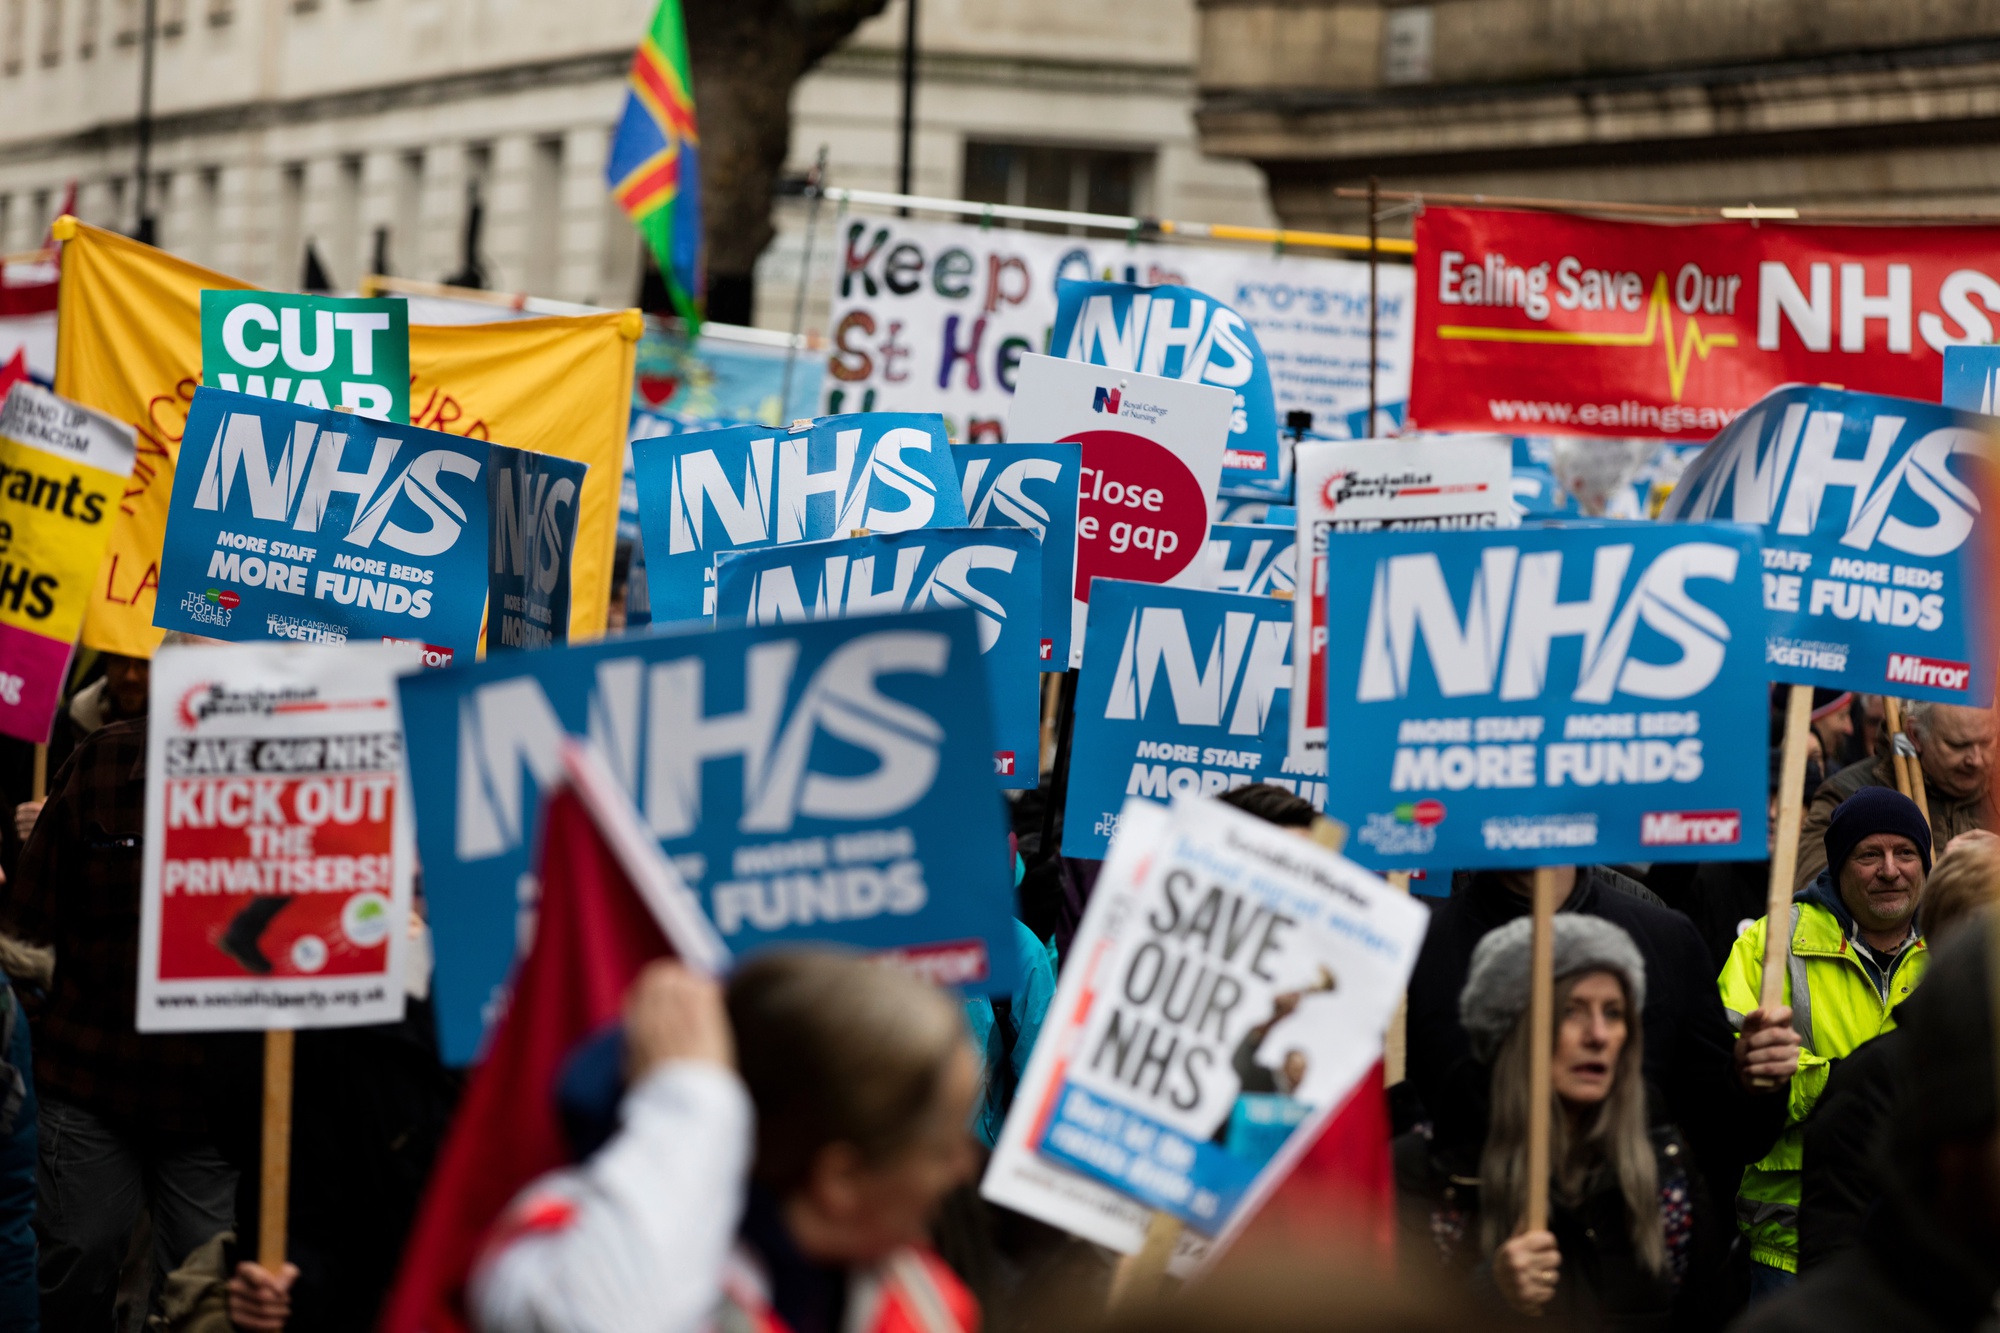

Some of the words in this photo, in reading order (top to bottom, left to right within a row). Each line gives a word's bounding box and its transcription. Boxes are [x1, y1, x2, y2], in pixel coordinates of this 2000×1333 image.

[840, 222, 1031, 314] Keep
[1438, 250, 1551, 321] Ealing
[1556, 255, 1643, 313] Save
[1675, 262, 1741, 316] Our
[221, 301, 390, 372] CUT
[1757, 260, 2000, 357] NHS
[828, 310, 910, 383] St
[1065, 293, 1255, 387] NHS
[1123, 400, 1142, 412] Royal
[1142, 403, 1169, 417] College
[1130, 410, 1157, 425] Nursing
[1488, 397, 1749, 434] www.ealingsav
[193, 410, 482, 557] NHS
[669, 427, 938, 556] NHS
[1685, 403, 1998, 557] NHS
[216, 530, 269, 553] MORE
[270, 540, 318, 564] STAFF
[333, 553, 387, 577] MORE
[389, 563, 434, 586] BEDS
[494, 467, 577, 596] NHS
[1109, 516, 1179, 560] gap
[0, 561, 59, 621] HS
[187, 591, 206, 604] THE
[206, 550, 307, 598] MORE
[315, 571, 434, 619] FUNDS
[1761, 548, 1813, 572] TAFF
[1829, 557, 1891, 584] MORE
[1893, 563, 1945, 591] BEDS
[191, 613, 232, 627] ASSEMBLY
[267, 613, 300, 627] HEALTH
[301, 618, 349, 636] CAMPAIGNS
[1356, 541, 1741, 704] NHS
[1809, 578, 1946, 632] FUNDS
[1888, 654, 1969, 689] Mirror
[164, 738, 248, 775] SAVE
[326, 733, 400, 771] NHS
[457, 630, 949, 862] NHS
[1136, 740, 1199, 764] MORE
[1202, 747, 1262, 770] STAFF
[1396, 717, 1473, 744] MORE
[1475, 715, 1546, 742] STAFF
[1563, 713, 1636, 739] MORE
[1639, 710, 1701, 736] BEDS
[1389, 744, 1537, 791] MORE
[1544, 738, 1705, 787] FUNDS
[167, 781, 284, 829] KICK
[294, 777, 392, 825] OUT
[1643, 812, 1739, 844] Mirror
[246, 824, 314, 859] THE
[162, 853, 392, 898] PRIVATISERS!
[711, 858, 928, 936] FUNDS
[1148, 869, 1298, 984] SAVE
[1124, 941, 1244, 1043] OUR
[1091, 1009, 1217, 1111] NHS
